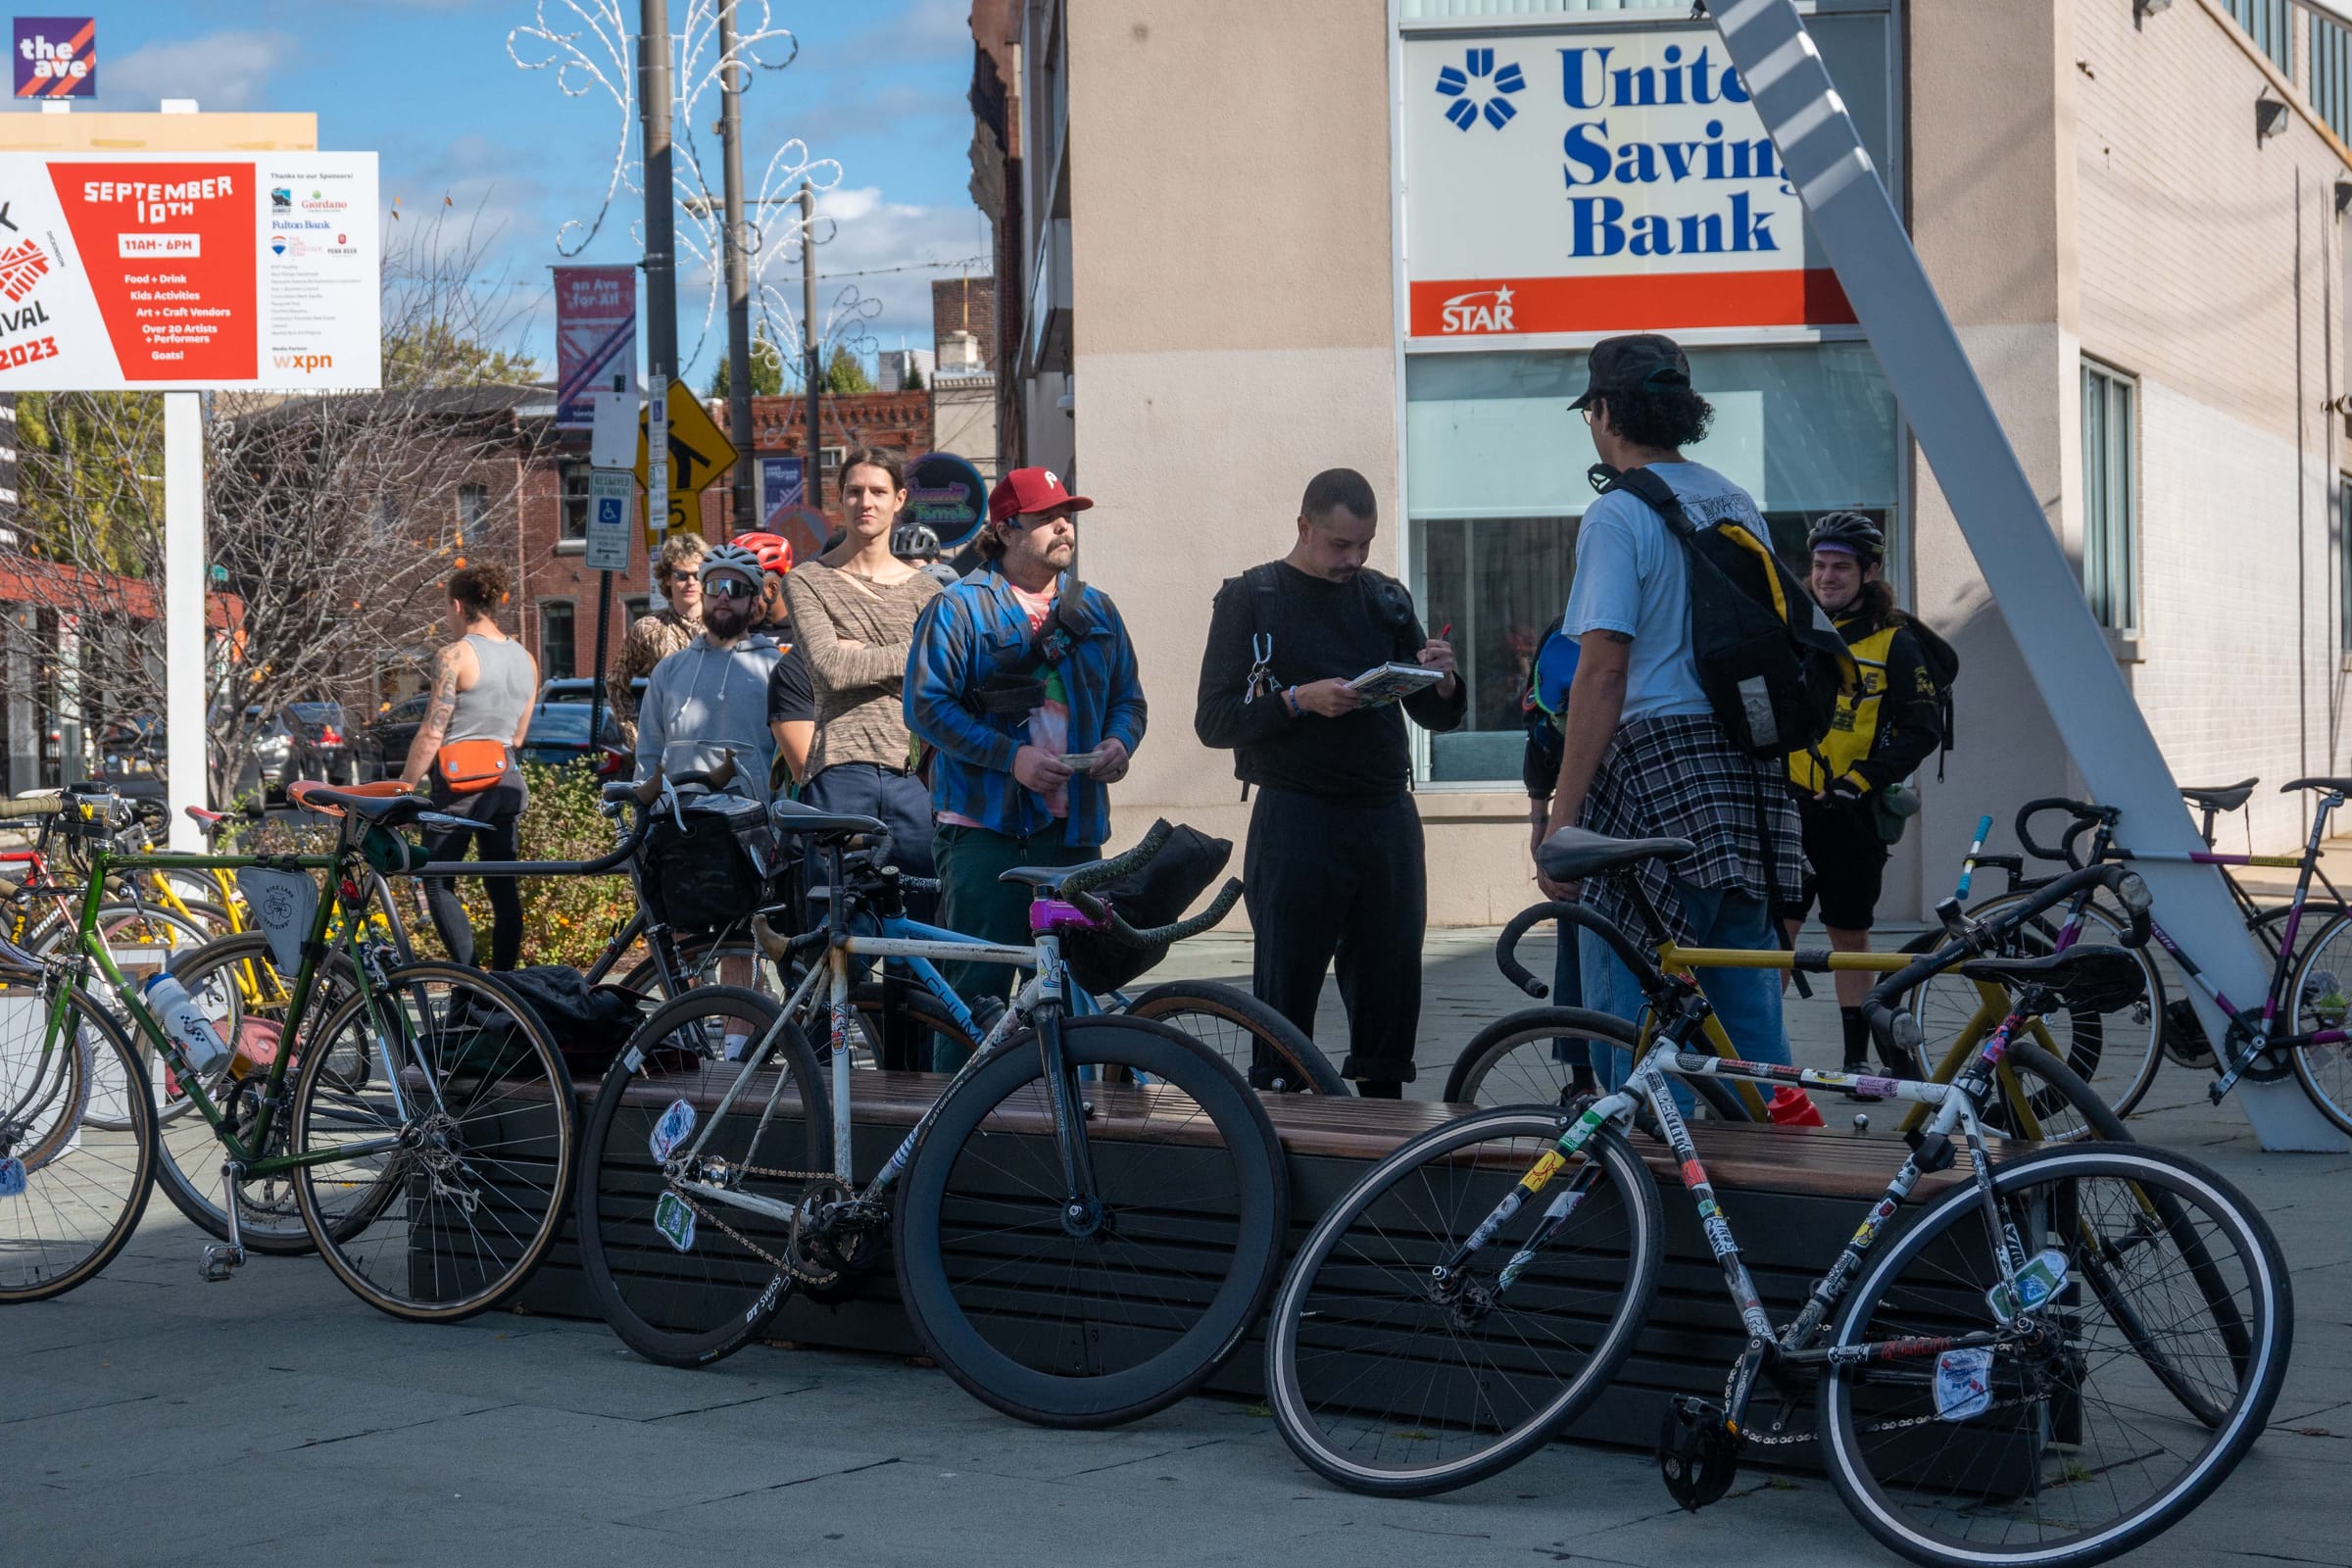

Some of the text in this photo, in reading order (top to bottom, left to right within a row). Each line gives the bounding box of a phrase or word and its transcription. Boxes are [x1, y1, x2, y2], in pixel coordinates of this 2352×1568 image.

[20, 35, 74, 61] the
[33, 60, 88, 79] ave
[1556, 44, 1752, 110] Unite
[1563, 118, 1800, 195] Savin
[83, 175, 233, 203] SEPTEMBER
[137, 200, 194, 224] 10TH
[301, 199, 348, 210] Giordano
[271, 220, 331, 229] Fulton Bank
[1567, 190, 1781, 258] Bank
[125, 240, 156, 251] 11AM
[167, 240, 192, 251] 6PM
[124, 274, 149, 284] Food
[160, 274, 187, 284] Drink
[572, 278, 619, 291] an Ave
[130, 291, 201, 301] Kids Activities
[572, 293, 619, 306] for All
[0, 300, 50, 336] VAL
[136, 308, 153, 318] Art
[163, 308, 188, 318] Craft
[190, 308, 231, 318] Vendors
[1442, 306, 1516, 332] STAR
[142, 323, 218, 334] Over 20 Artists
[154, 334, 210, 344] Performers
[0, 335, 60, 372] 2023
[152, 351, 184, 361] Goats!
[272, 354, 333, 374] wxpn
[667, 498, 687, 528] 5
[746, 1273, 781, 1324] DT SWISS
